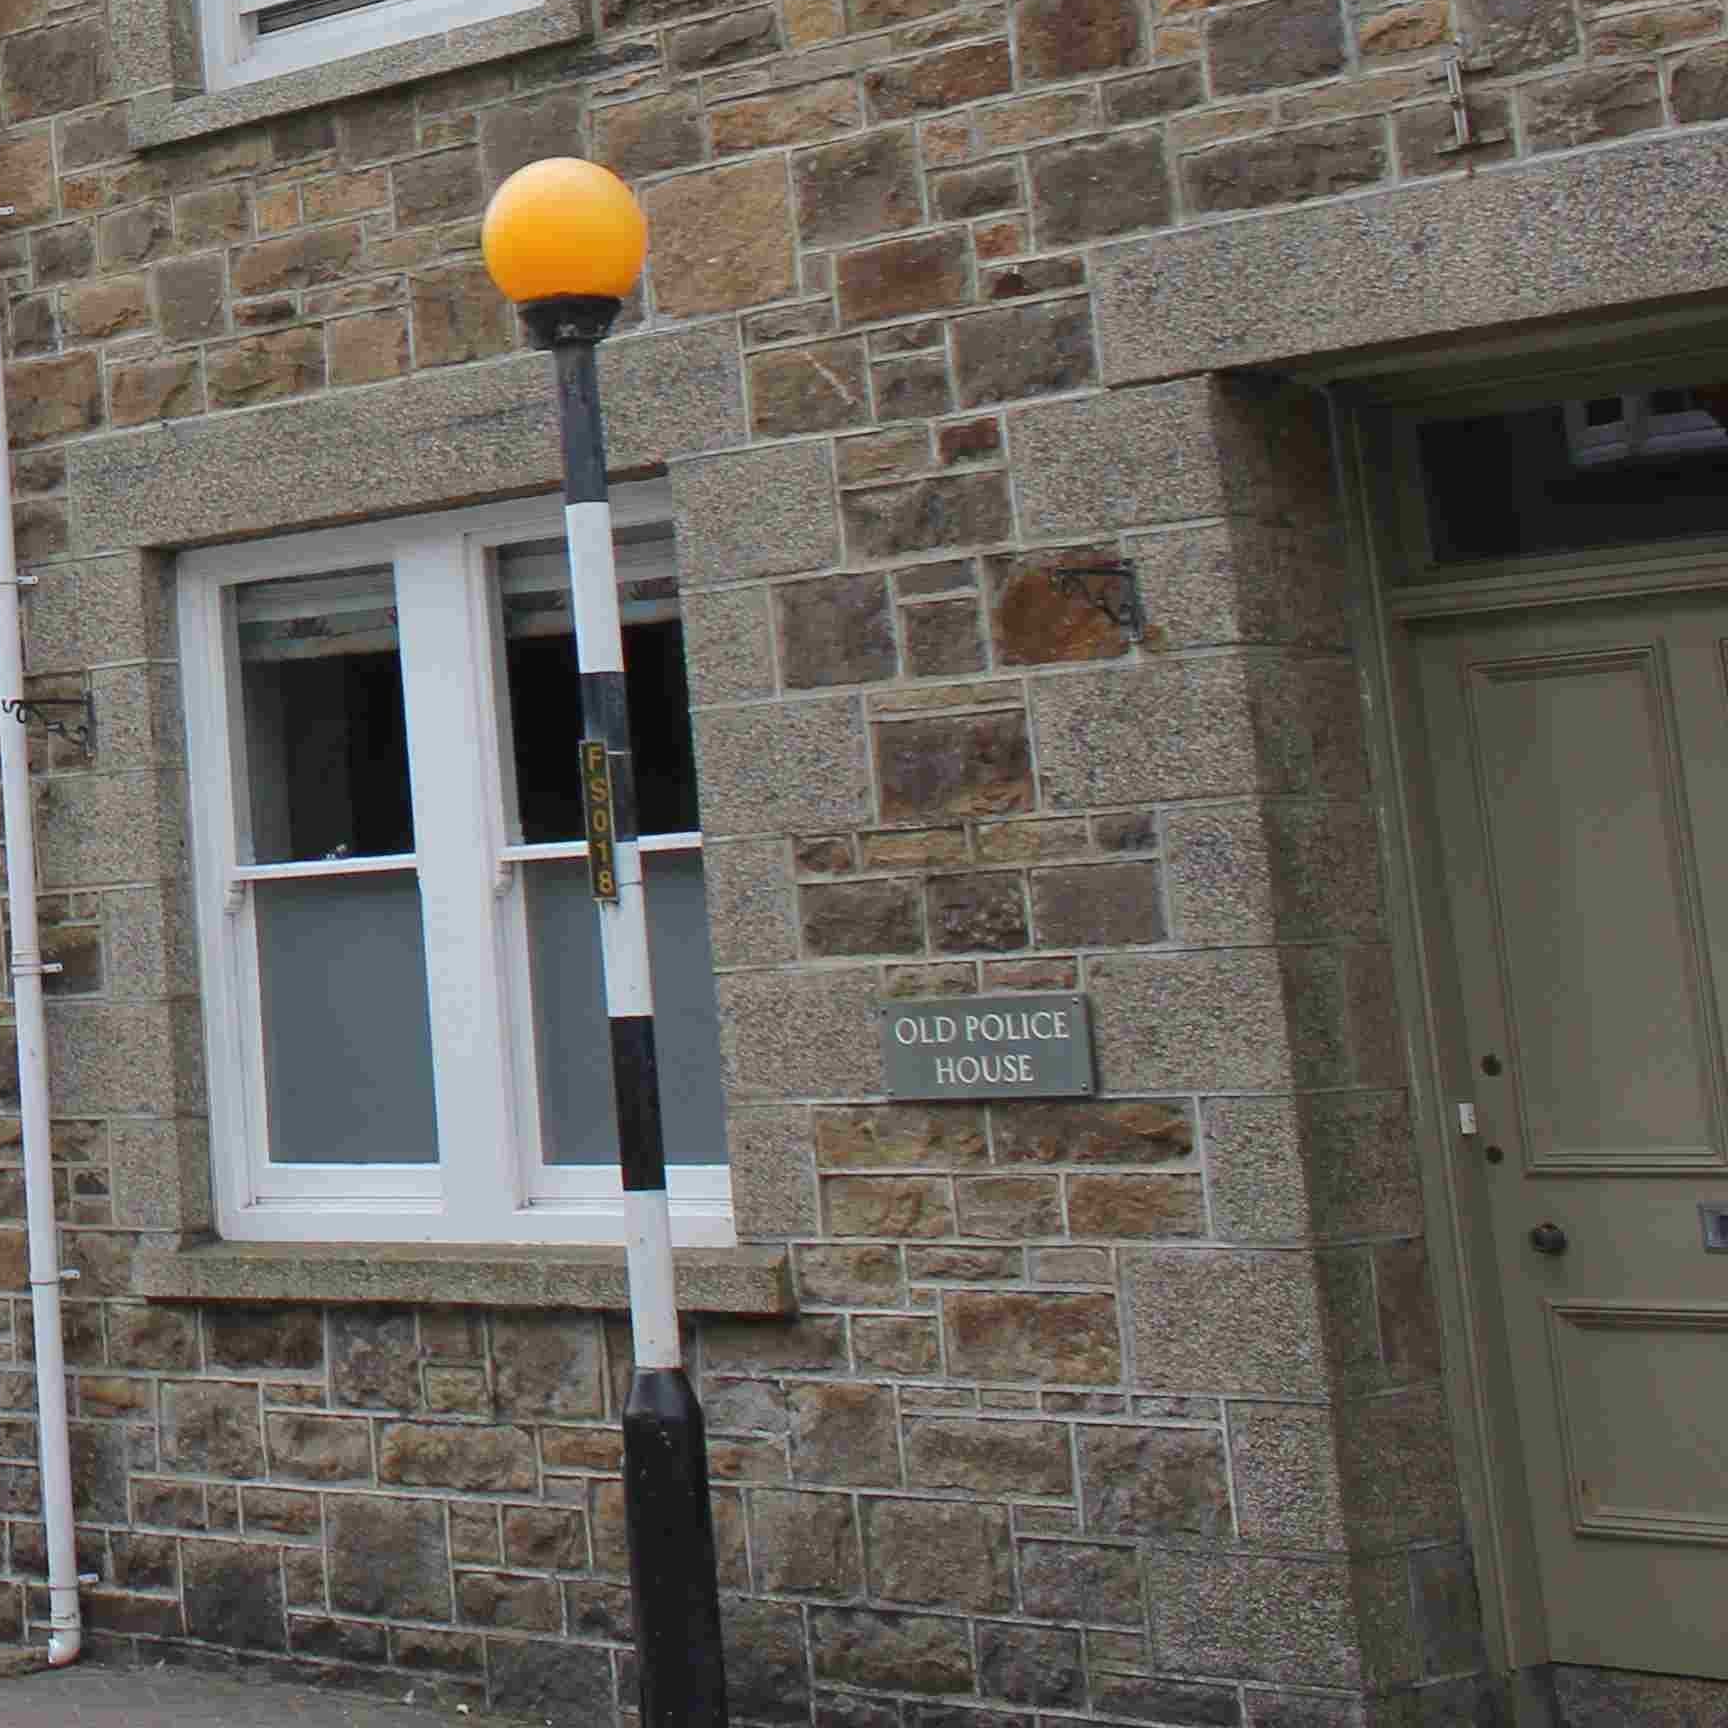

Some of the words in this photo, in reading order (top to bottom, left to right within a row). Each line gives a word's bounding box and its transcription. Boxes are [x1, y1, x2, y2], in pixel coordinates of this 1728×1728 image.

[589, 746, 614, 896] FS018
[895, 1016, 957, 1044] OLD
[966, 1012, 1070, 1041] POLICE
[936, 1055, 1033, 1084] HOUSE
